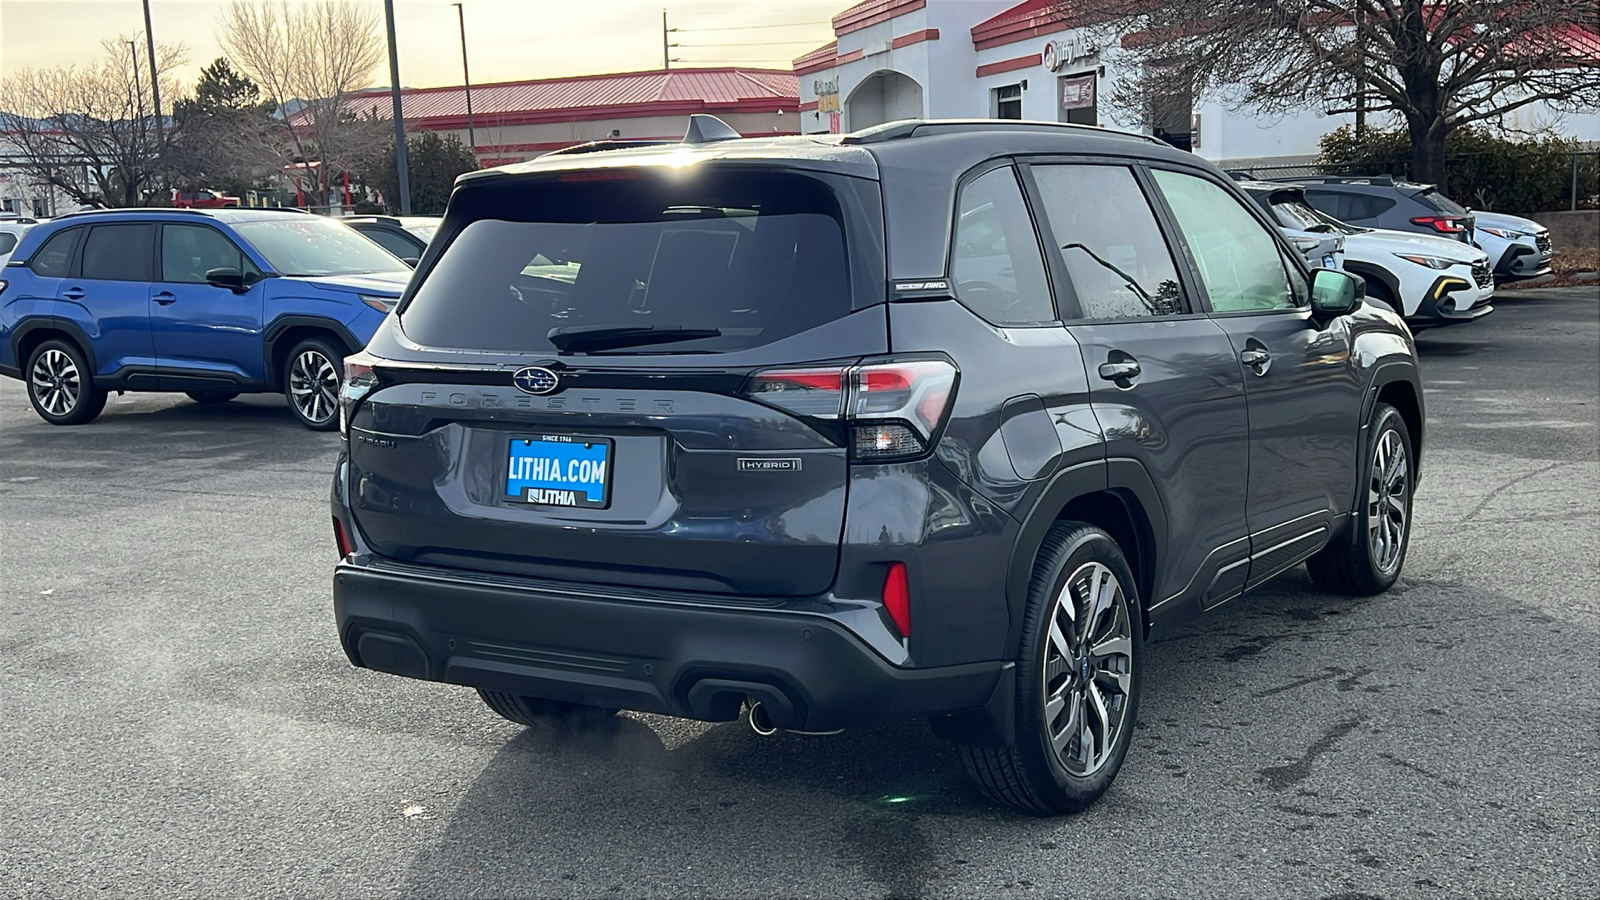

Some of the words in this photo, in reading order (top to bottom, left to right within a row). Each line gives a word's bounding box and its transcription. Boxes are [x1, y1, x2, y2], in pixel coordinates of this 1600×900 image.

[421, 391, 675, 415] FORESTER
[357, 436, 397, 449] SUBARU
[508, 456, 606, 485] LITHIA.COM
[538, 488, 576, 506] LITHIA
